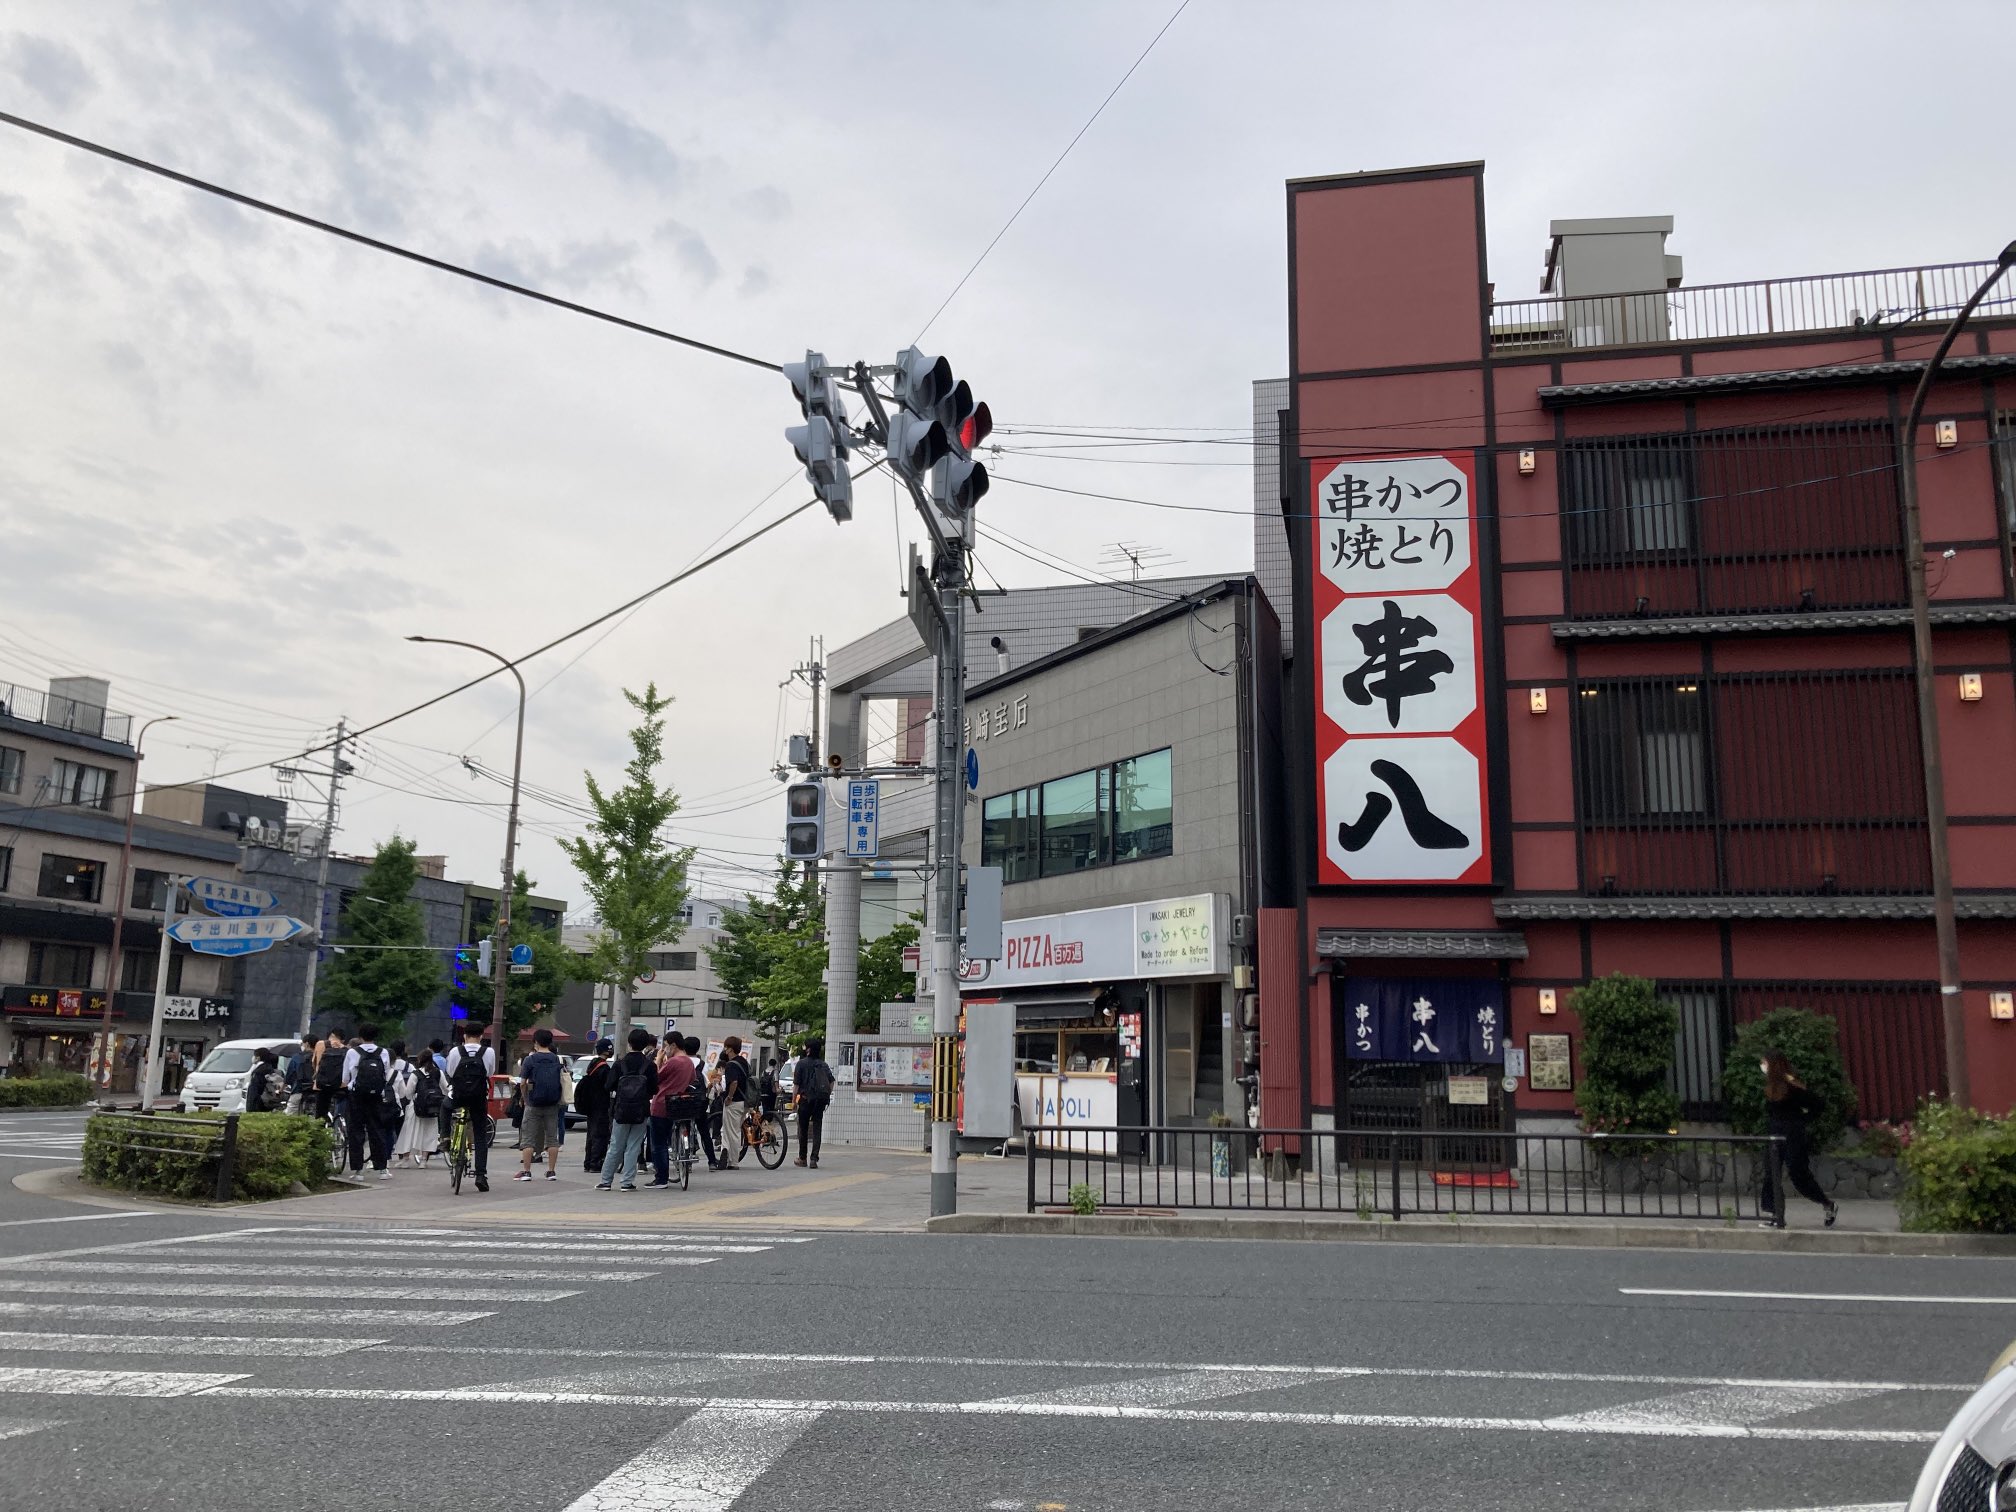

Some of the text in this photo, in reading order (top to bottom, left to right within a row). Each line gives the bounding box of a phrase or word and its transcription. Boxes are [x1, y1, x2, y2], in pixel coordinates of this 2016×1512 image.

[1326, 474, 1462, 522] 串かつ
[1330, 519, 1454, 570] 焼とり
[851, 786, 862, 823] 自転車
[864, 785, 875, 823] 歩行者
[857, 826, 868, 852] 専用
[191, 922, 275, 936] 今出川通り
[1150, 907, 1196, 922] IWASAKI JEWELRY
[1007, 934, 1052, 969] PIZZA
[1155, 950, 1161, 958] to
[1163, 948, 1178, 957] order
[1181, 947, 1187, 955] &
[667, 1019, 675, 1030] P
[1355, 1003, 1373, 1051] 串かつ
[1412, 996, 1440, 1053] 串八
[1477, 1006, 1496, 1056] 焼とり
